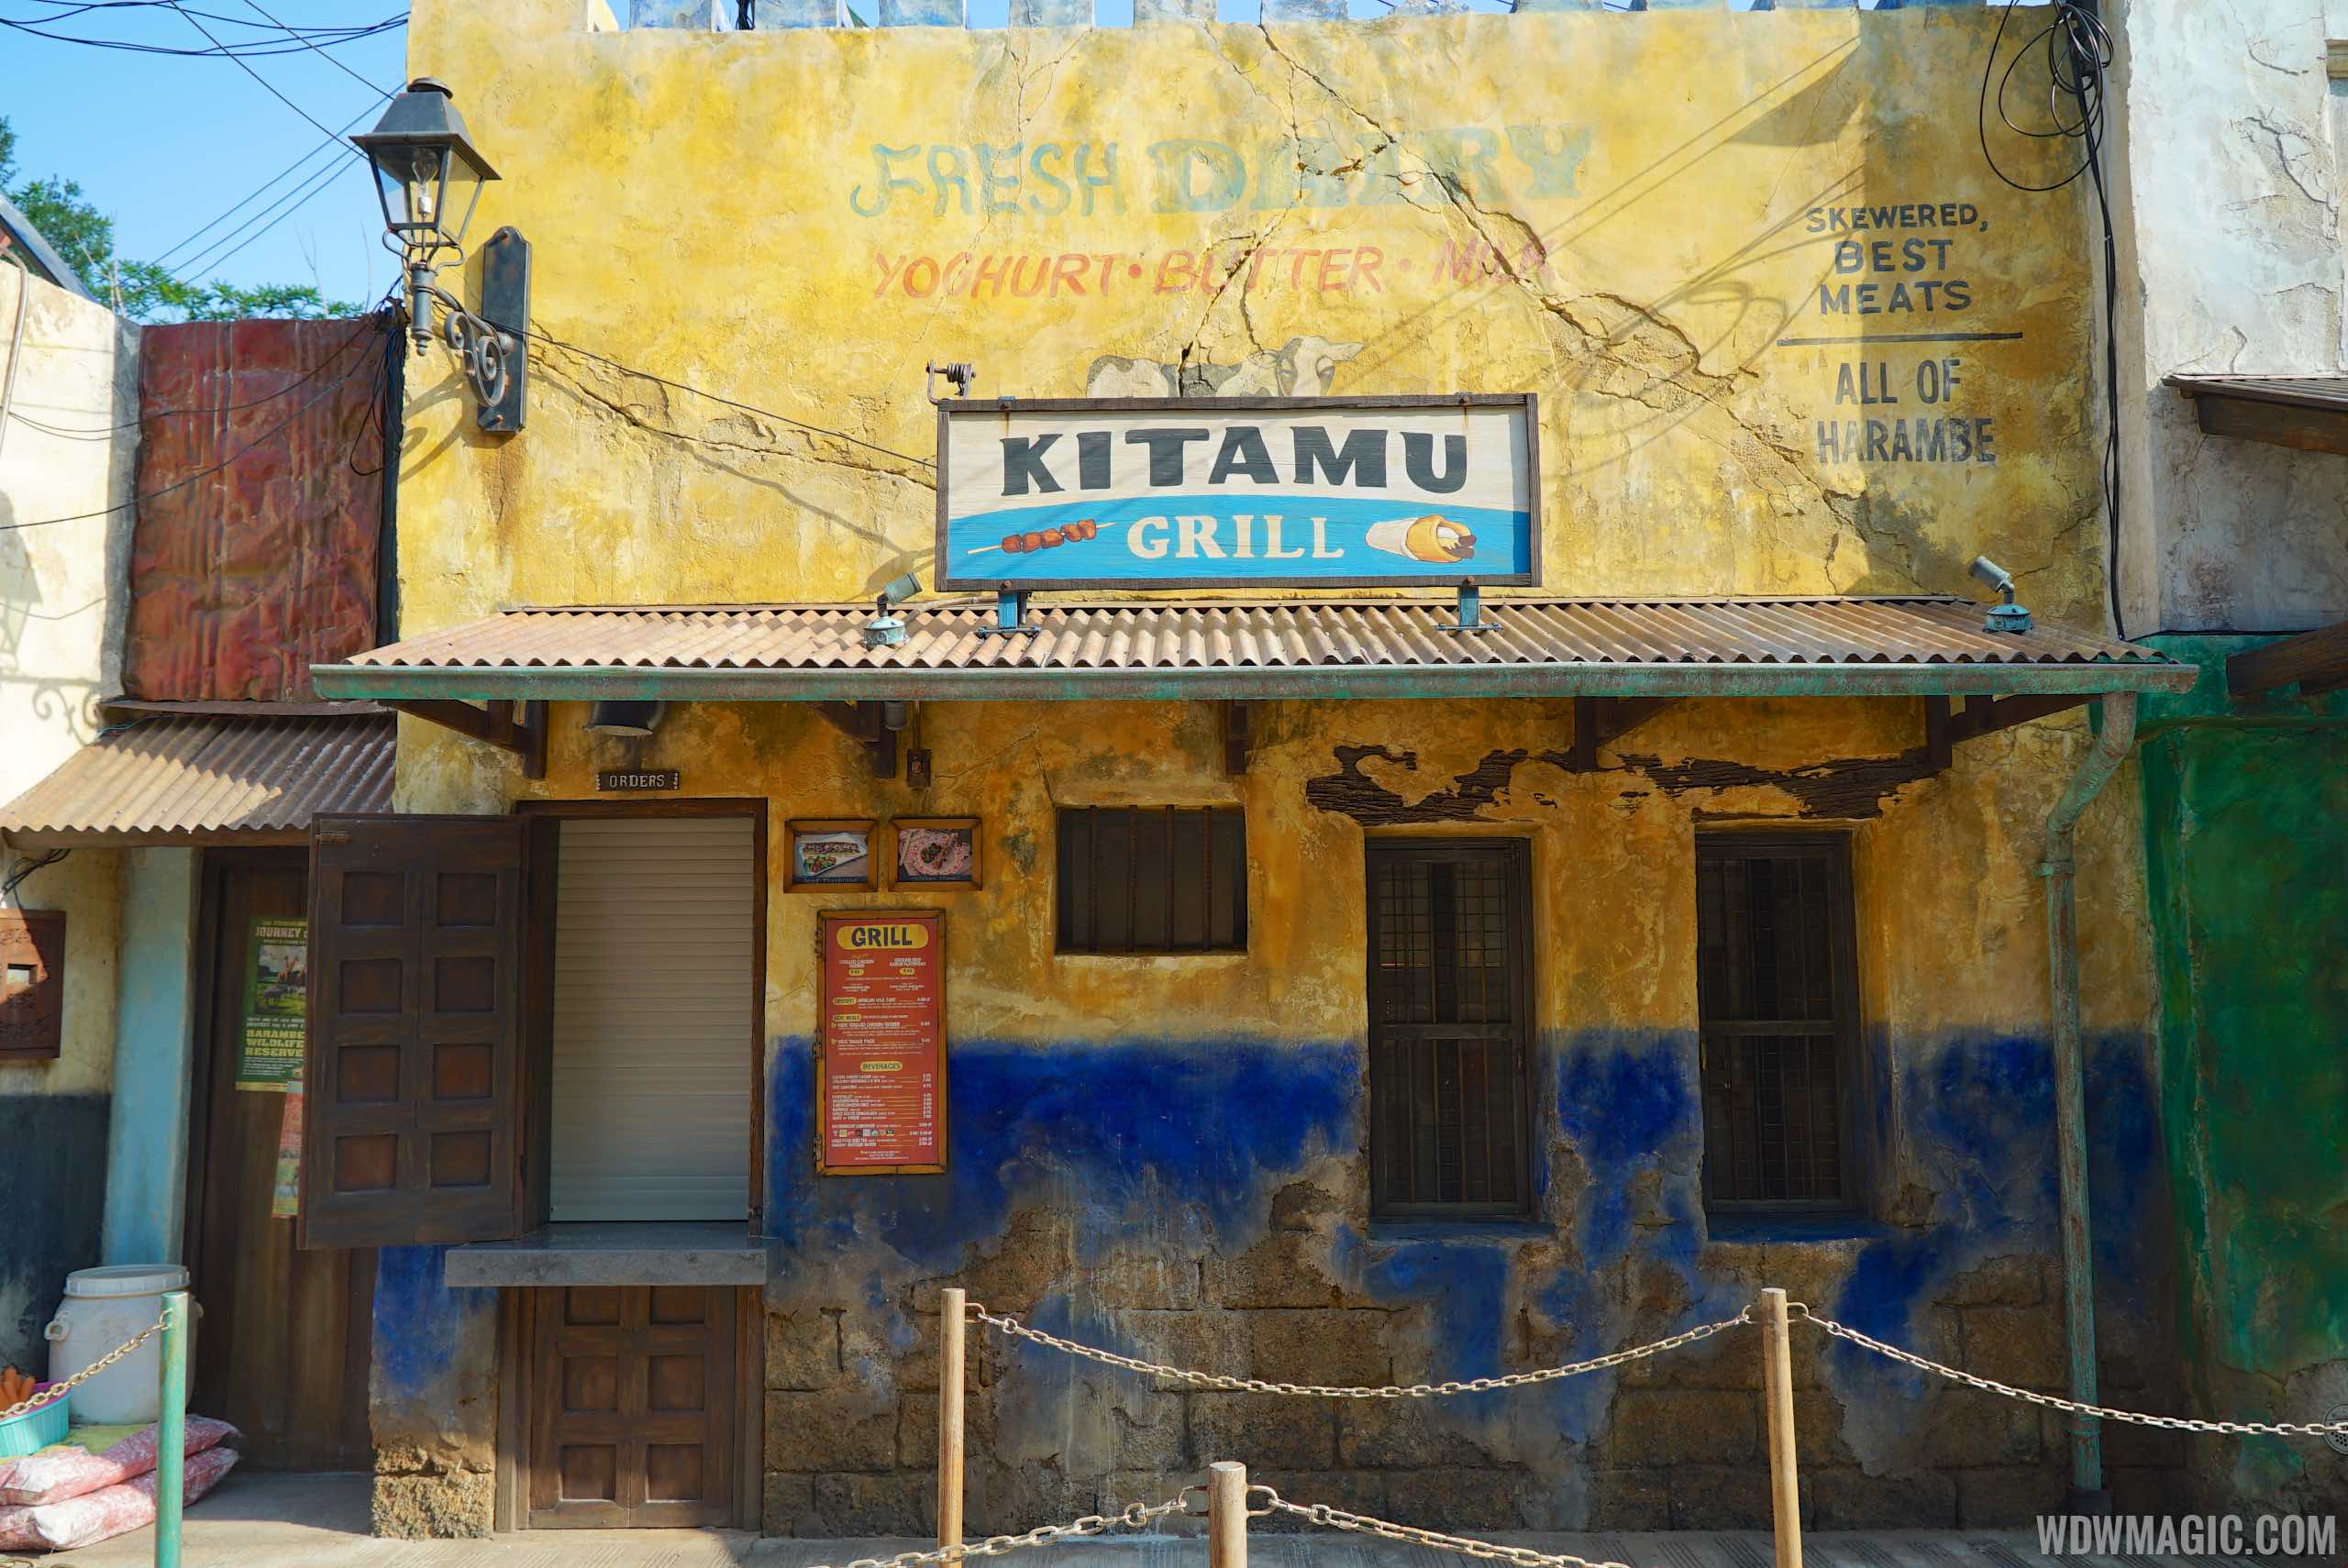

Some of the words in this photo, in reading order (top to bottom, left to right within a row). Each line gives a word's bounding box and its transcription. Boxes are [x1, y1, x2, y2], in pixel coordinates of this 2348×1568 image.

[850, 140, 1127, 217] FRESH
[1146, 124, 1594, 213] DAIRY
[1804, 203, 1988, 233] SKEWERED,
[872, 251, 1124, 299] YOGHURT
[1153, 245, 1384, 294] BUTTER
[1834, 237, 1954, 275] BEST
[1820, 280, 1972, 315] MEATS
[1834, 361, 1898, 405] ALL
[1916, 359, 1963, 404] OF
[1815, 417, 1997, 464] HARAMBE
[999, 425, 1468, 496] KITAMU
[1126, 514, 1345, 559] GRILL
[609, 774, 666, 789] ORDERS
[255, 926, 301, 938] JOURNEY
[850, 926, 913, 947] GRILL
[246, 1029, 305, 1039] HARAMBE
[246, 1038, 305, 1047] WILDLIFE
[244, 1047, 304, 1056] RESERVE
[862, 1062, 901, 1071] BEVERAGES
